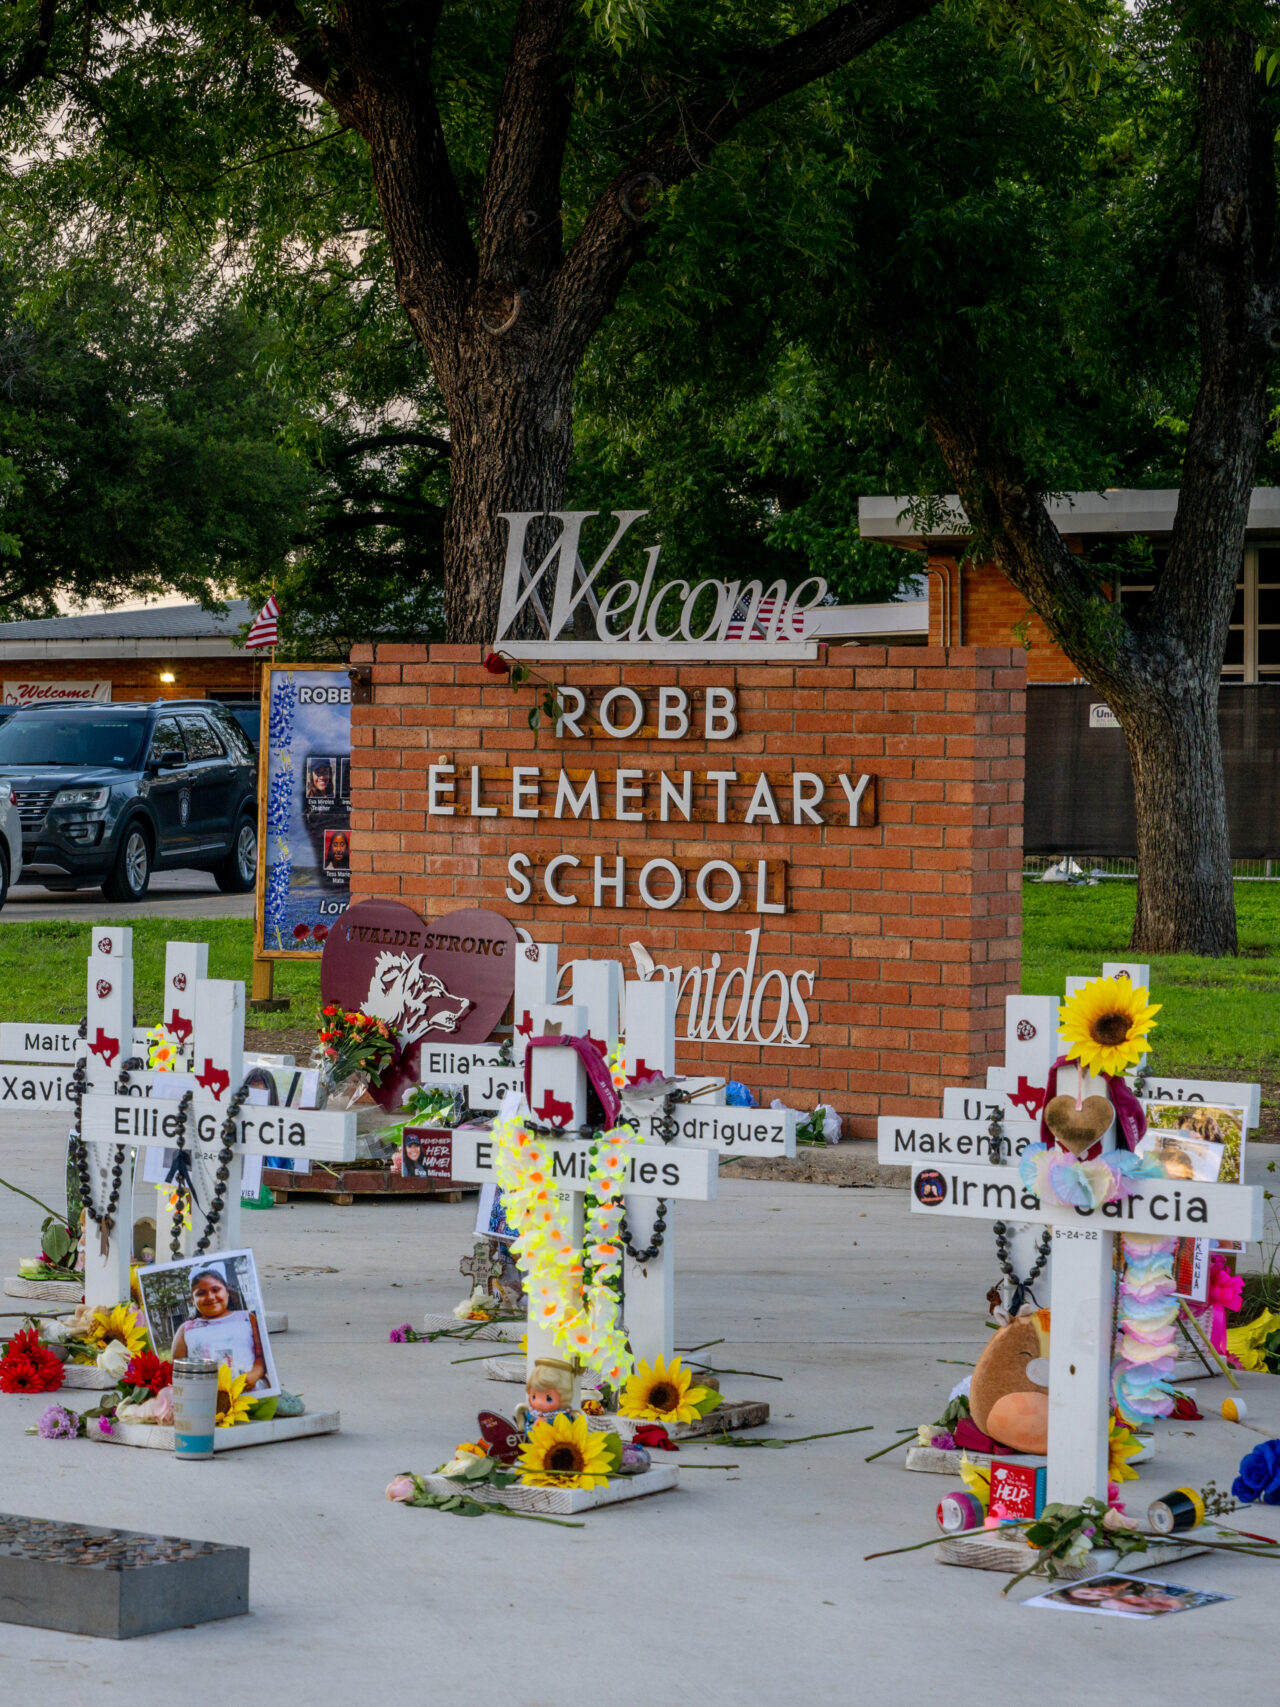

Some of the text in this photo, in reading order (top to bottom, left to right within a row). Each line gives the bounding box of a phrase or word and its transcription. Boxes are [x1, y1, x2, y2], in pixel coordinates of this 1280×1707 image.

[497, 509, 828, 643] Welcome
[17, 683, 100, 699] Welcome!
[299, 687, 351, 704] ROBB
[555, 686, 739, 740] ROBB
[428, 763, 871, 827] ELEMENTARY
[505, 852, 786, 914] SCHOOL
[345, 925, 420, 948] UVALDE
[424, 932, 508, 957] STRONG
[2, 1076, 94, 1101] Xavie
[114, 1107, 178, 1138] Ellie
[422, 1156, 450, 1168] NAME!
[426, 1145, 450, 1156] HER
[415, 1168, 451, 1178] Eva Mireles
[551, 1150, 681, 1186] Miles
[951, 1175, 1041, 1211] Irma
[1055, 1230, 1098, 1241] 5-24-22
[996, 1483, 1029, 1504] HELP
